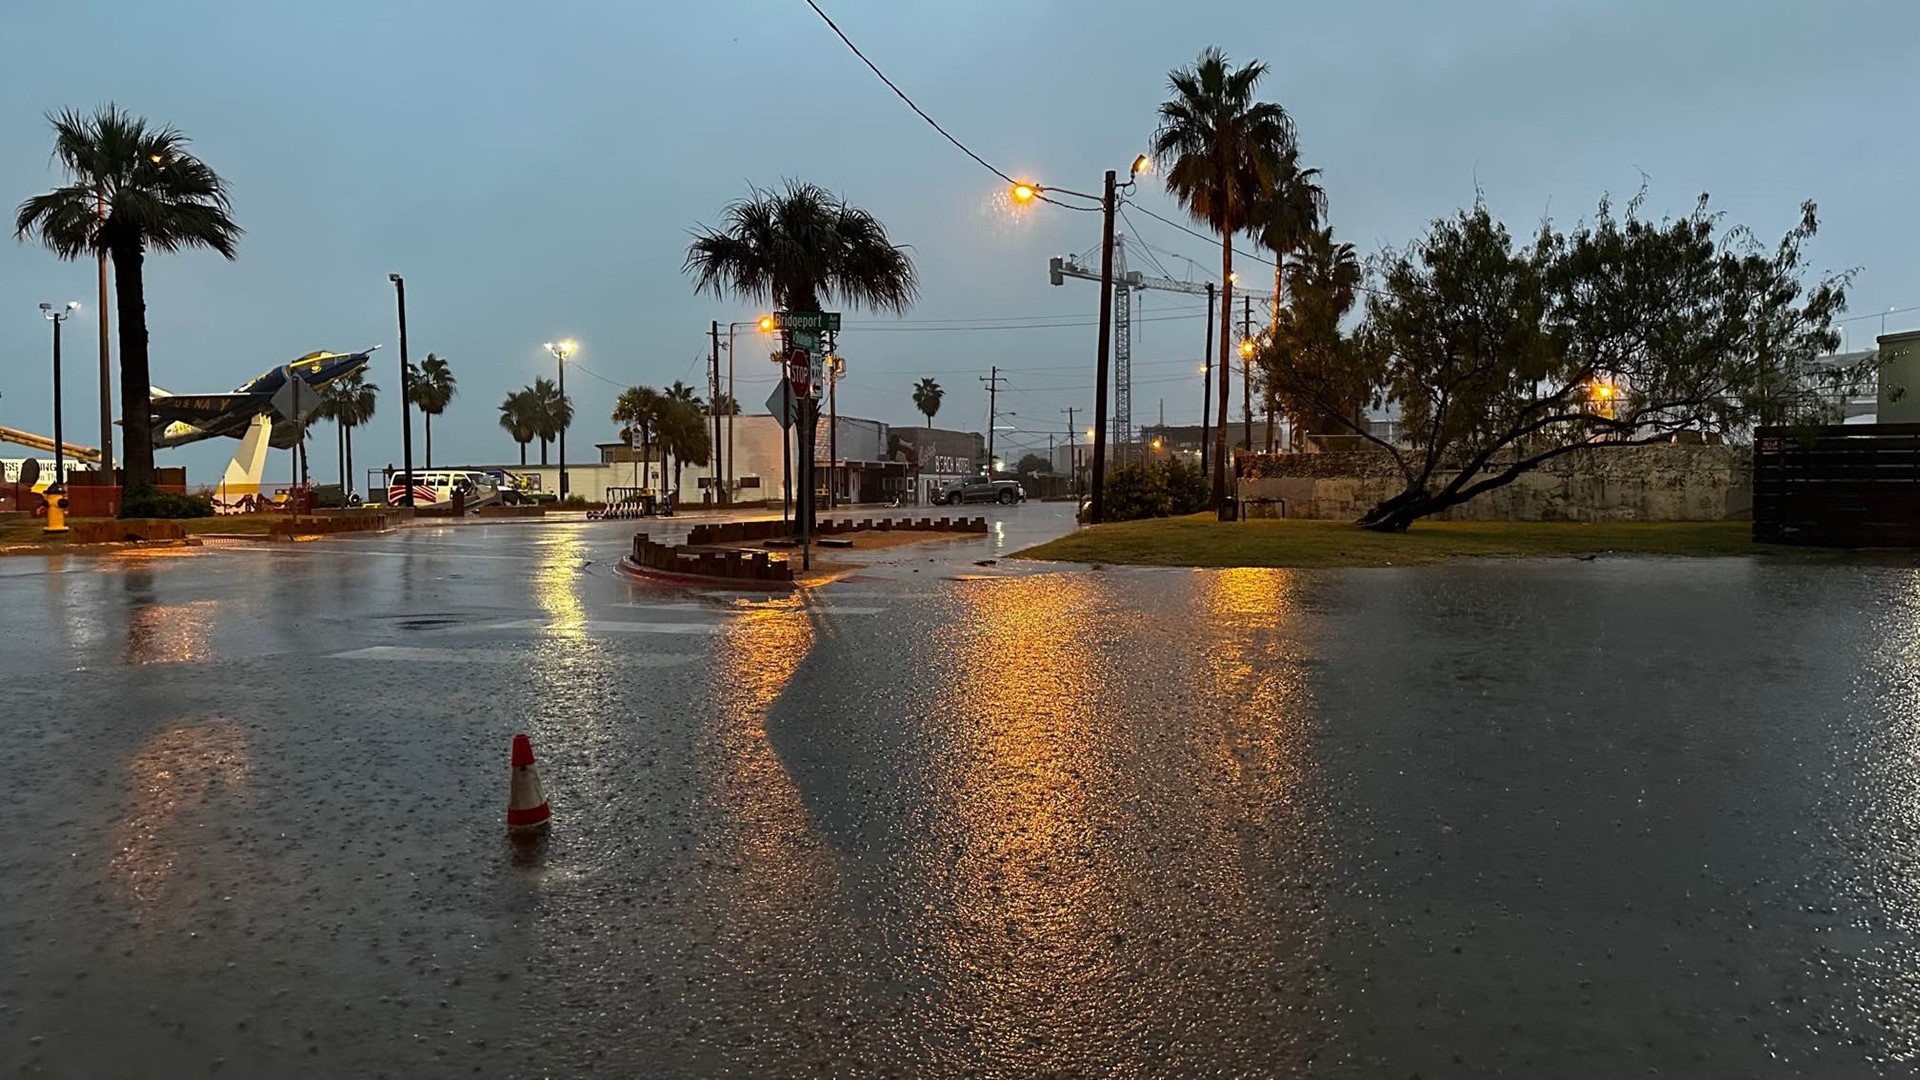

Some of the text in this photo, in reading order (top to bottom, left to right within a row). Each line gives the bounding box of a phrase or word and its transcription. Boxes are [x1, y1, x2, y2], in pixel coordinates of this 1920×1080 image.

[775, 313, 822, 330] Bridgeport
[811, 354, 822, 367] ONE
[791, 365, 808, 383] STOP
[811, 368, 822, 380] WAY
[193, 398, 231, 411] NAY
[935, 455, 971, 474] BEACH HOTEL
